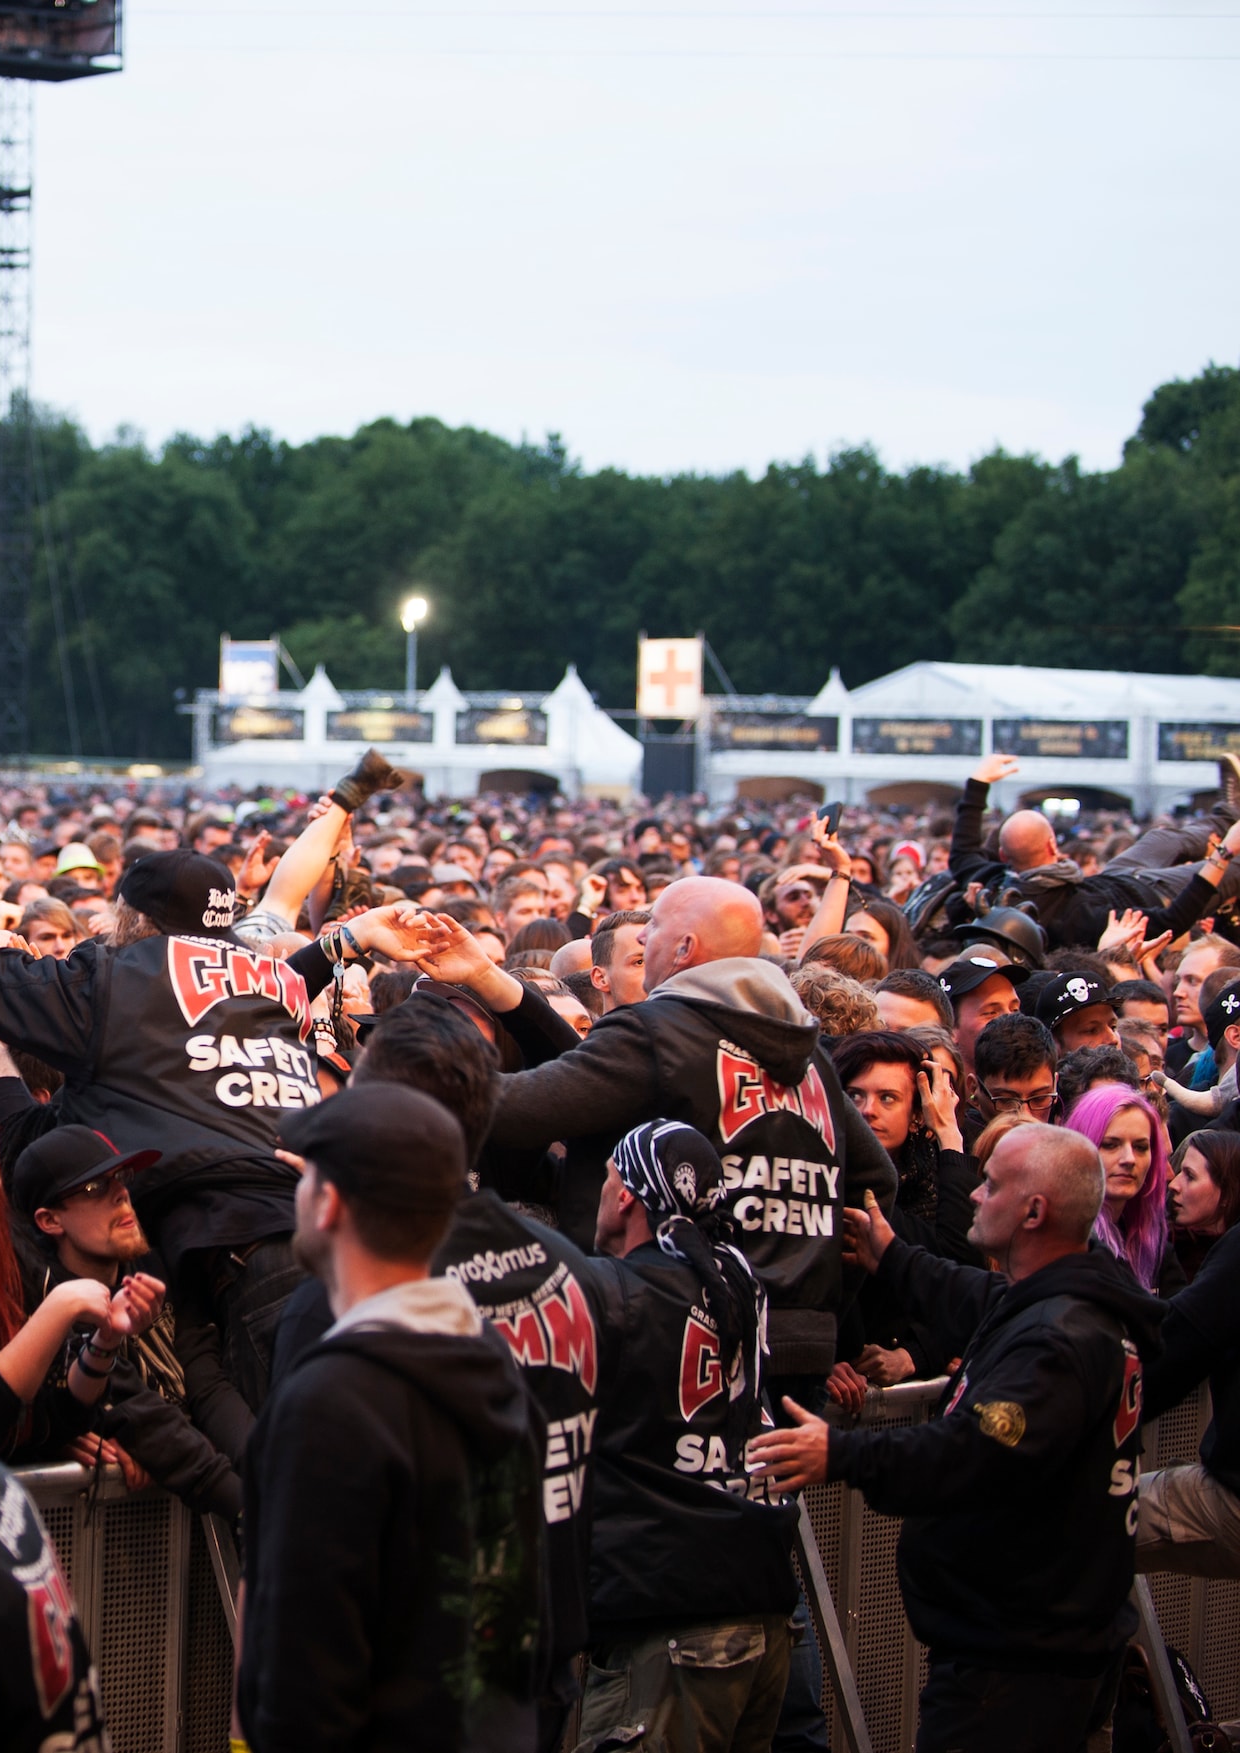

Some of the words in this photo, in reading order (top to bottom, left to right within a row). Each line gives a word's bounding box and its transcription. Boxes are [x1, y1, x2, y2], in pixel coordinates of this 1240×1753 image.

[168, 936, 313, 1047] GMM
[717, 1048, 836, 1156] GMM
[720, 1153, 840, 1199] SAFETY
[733, 1195, 834, 1237] CREW
[490, 1272, 598, 1398] MM
[544, 1407, 599, 1469] ETY
